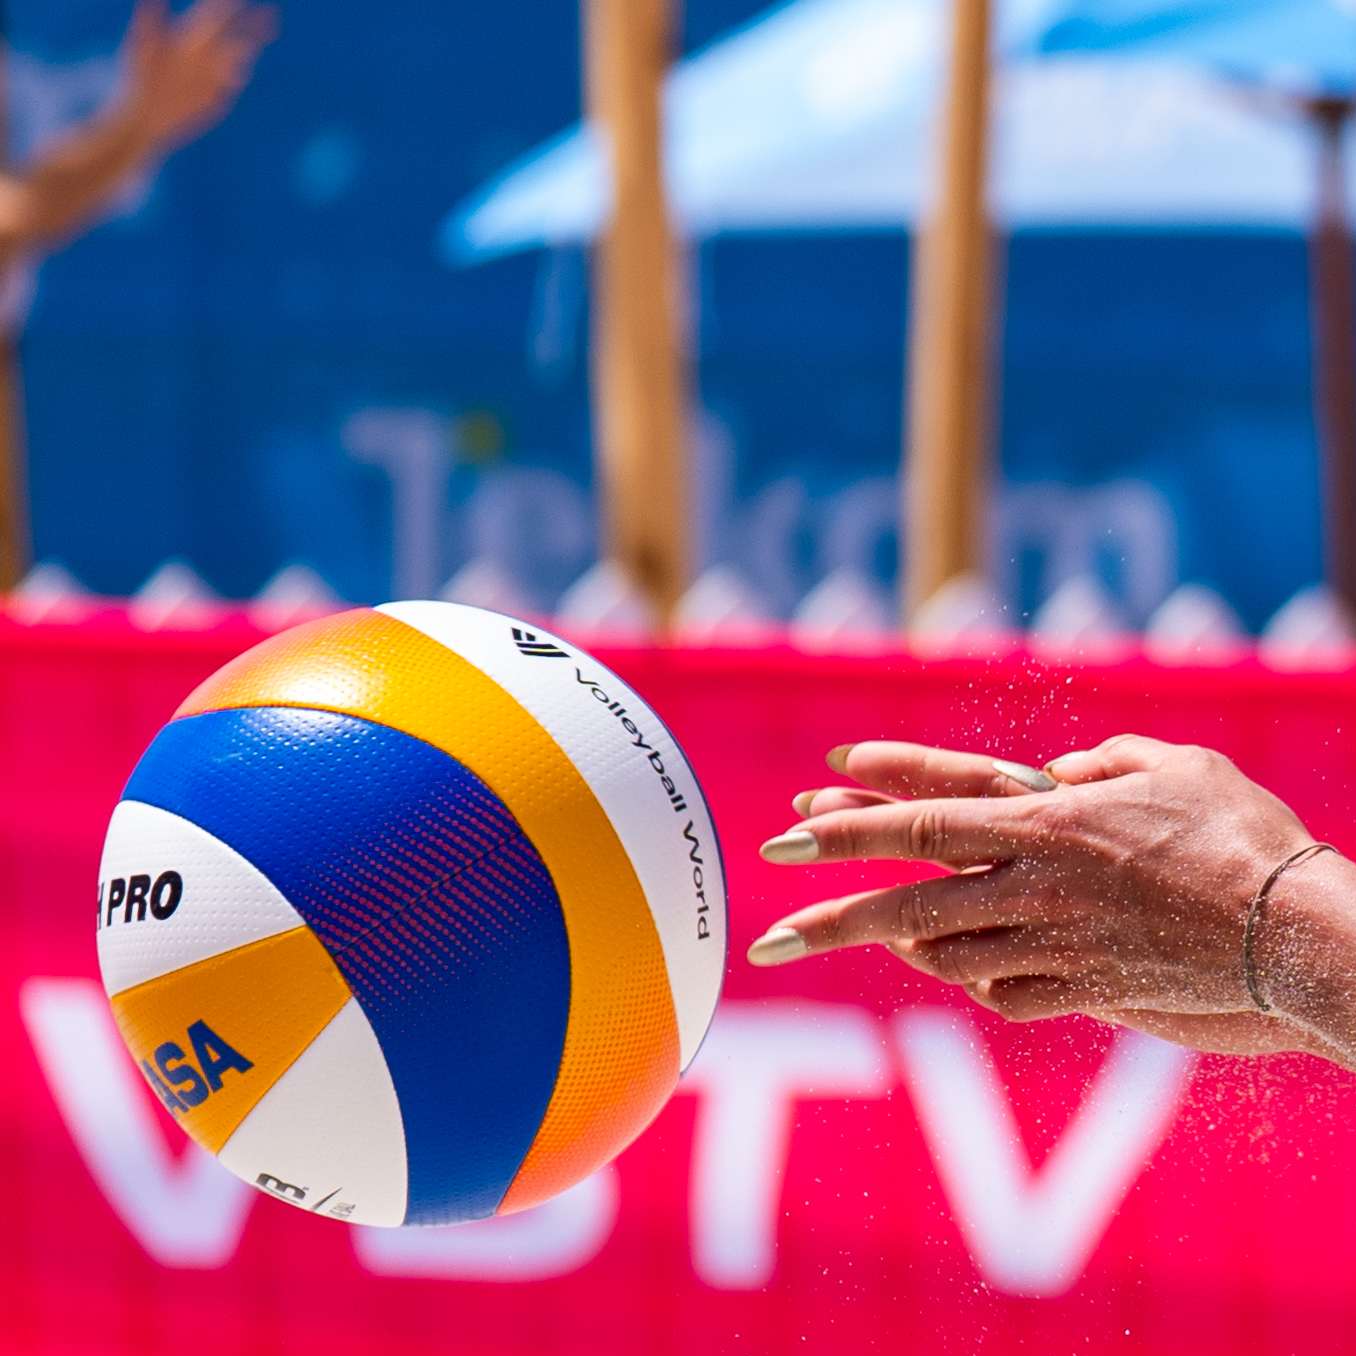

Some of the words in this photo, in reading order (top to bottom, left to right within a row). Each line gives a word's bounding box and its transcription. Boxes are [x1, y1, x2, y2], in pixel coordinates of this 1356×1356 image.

[106, 869, 184, 927] PRO
[575, 667, 687, 812] Volleyball
[683, 820, 710, 940] World
[22, 976, 1192, 1297] VTV
